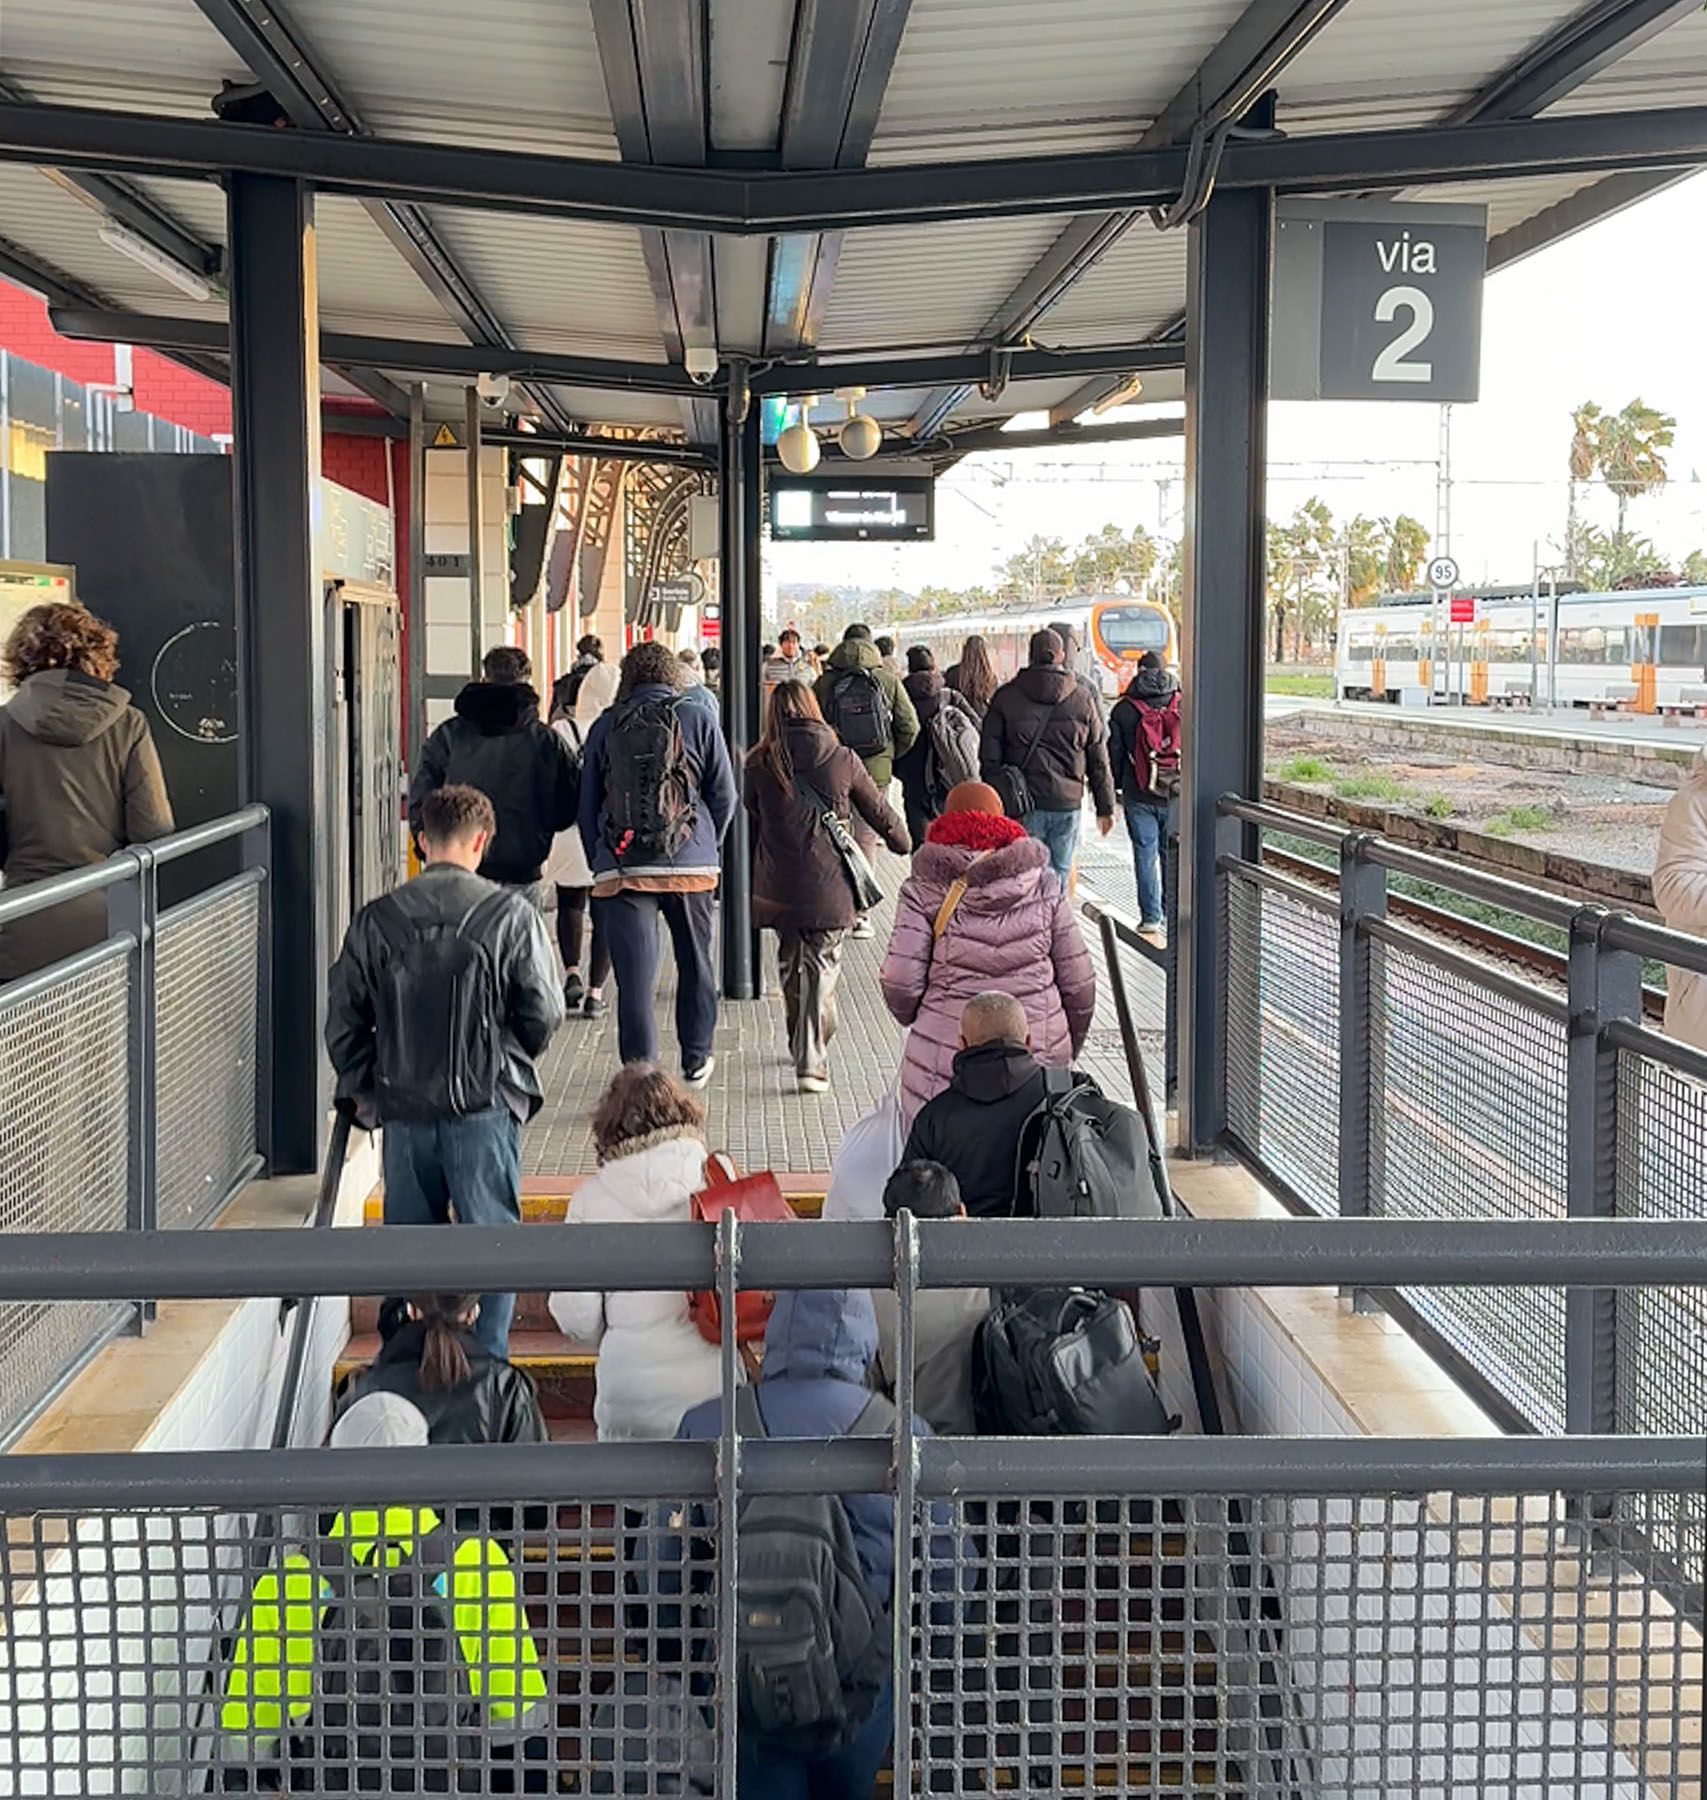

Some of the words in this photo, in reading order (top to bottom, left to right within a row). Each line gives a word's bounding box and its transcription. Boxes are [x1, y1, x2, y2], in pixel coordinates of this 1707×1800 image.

[1376, 231, 1437, 274] via
[1372, 286, 1433, 383] 2
[1435, 565, 1452, 580] 95
